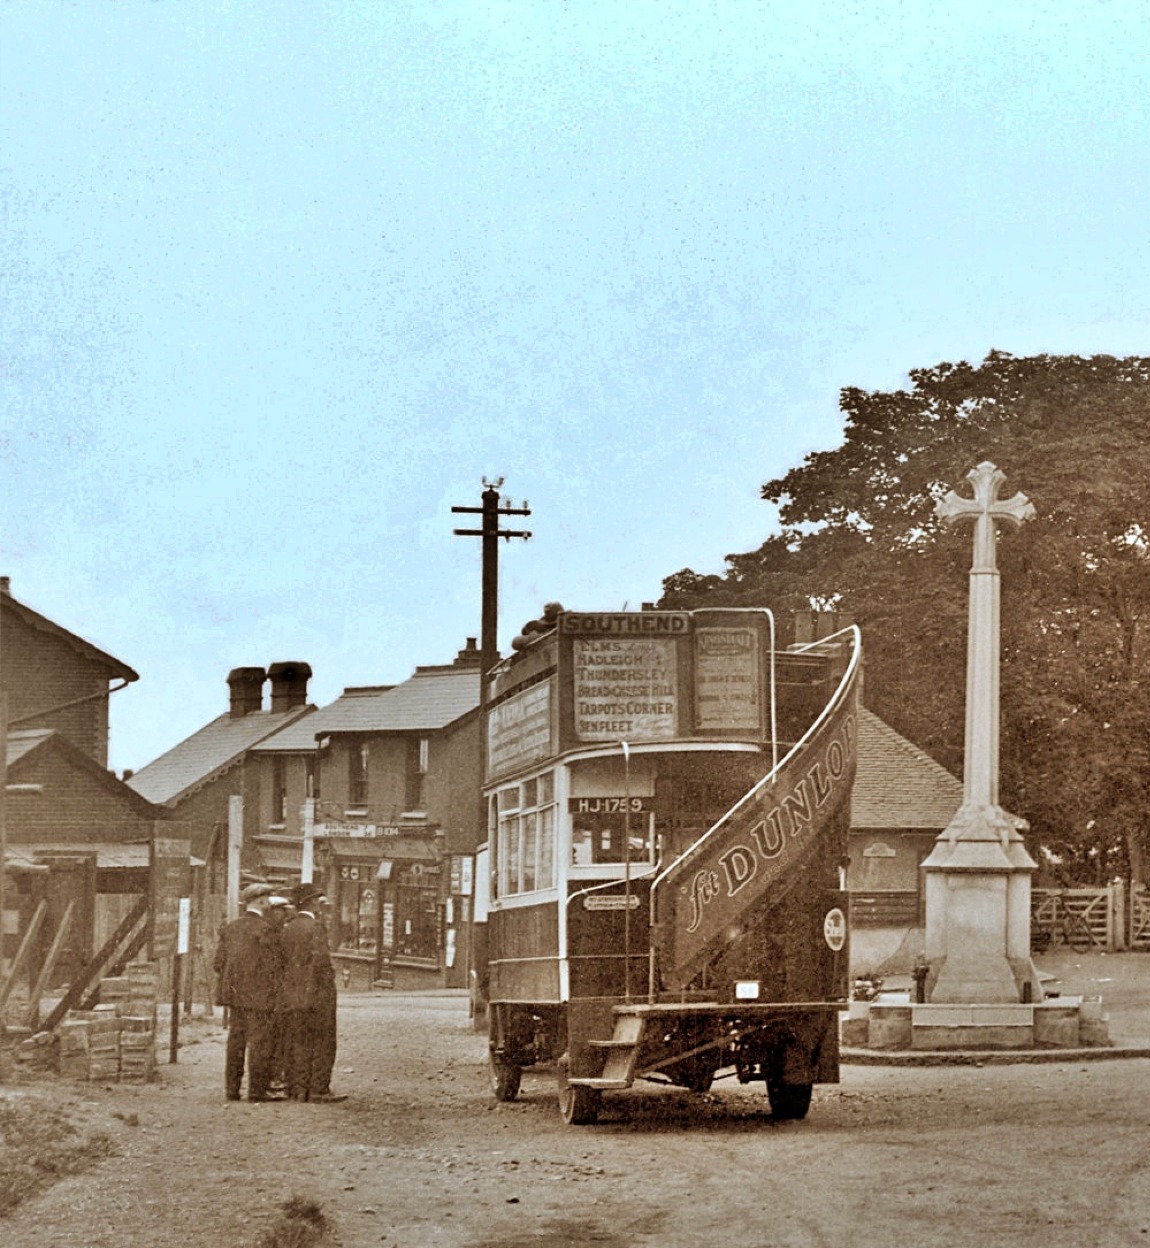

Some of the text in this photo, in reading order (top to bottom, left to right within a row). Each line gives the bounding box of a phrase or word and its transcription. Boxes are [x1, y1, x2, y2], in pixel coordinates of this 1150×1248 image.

[565, 615, 685, 632] SOUTHEND
[577, 667, 667, 681] THUNDERSLEY
[626, 702, 673, 715] CORNER
[719, 714, 857, 897] DUNLOP
